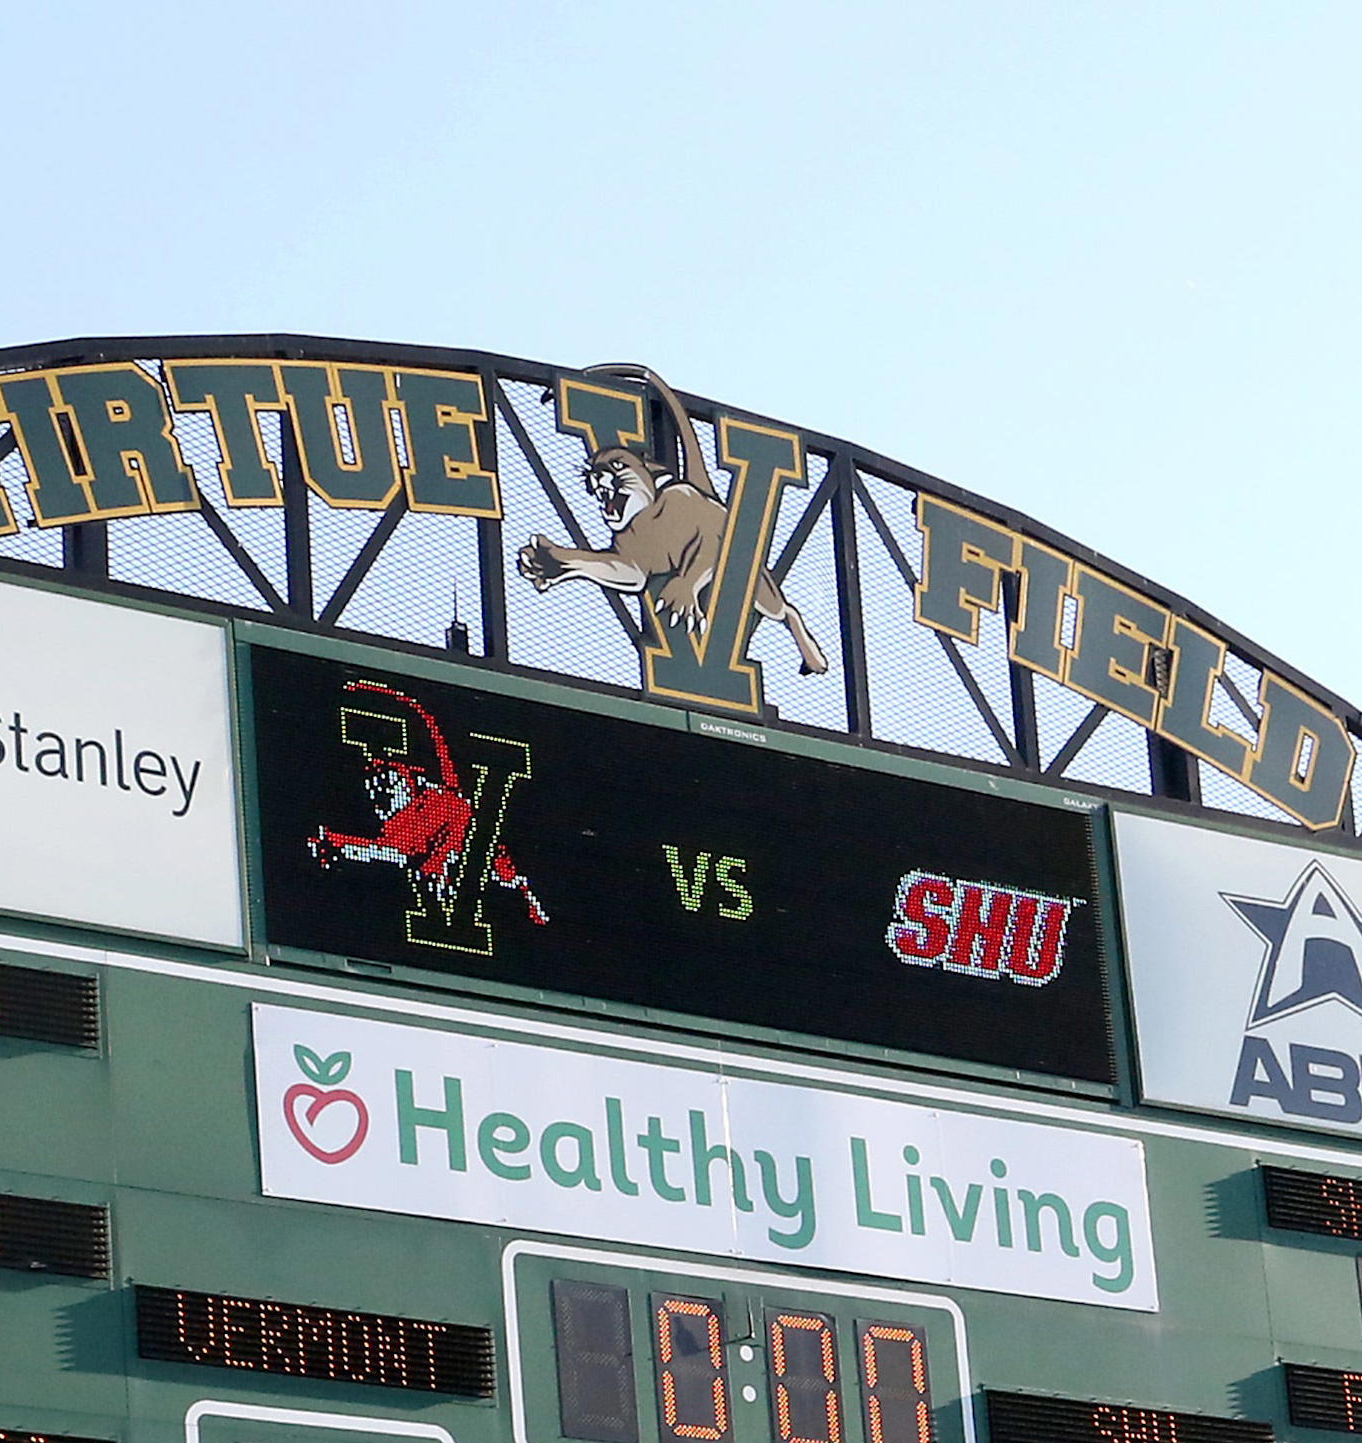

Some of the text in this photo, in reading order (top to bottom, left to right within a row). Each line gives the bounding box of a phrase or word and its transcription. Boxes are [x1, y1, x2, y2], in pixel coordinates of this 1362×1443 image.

[913, 492, 1359, 832] FIELD
[700, 722, 767, 743] DAKTRONICS
[661, 842, 754, 922] VS
[885, 868, 1074, 988] SHU
[394, 1068, 1134, 1294] Healthy Living
[175, 1293, 448, 1390] VERMONT
